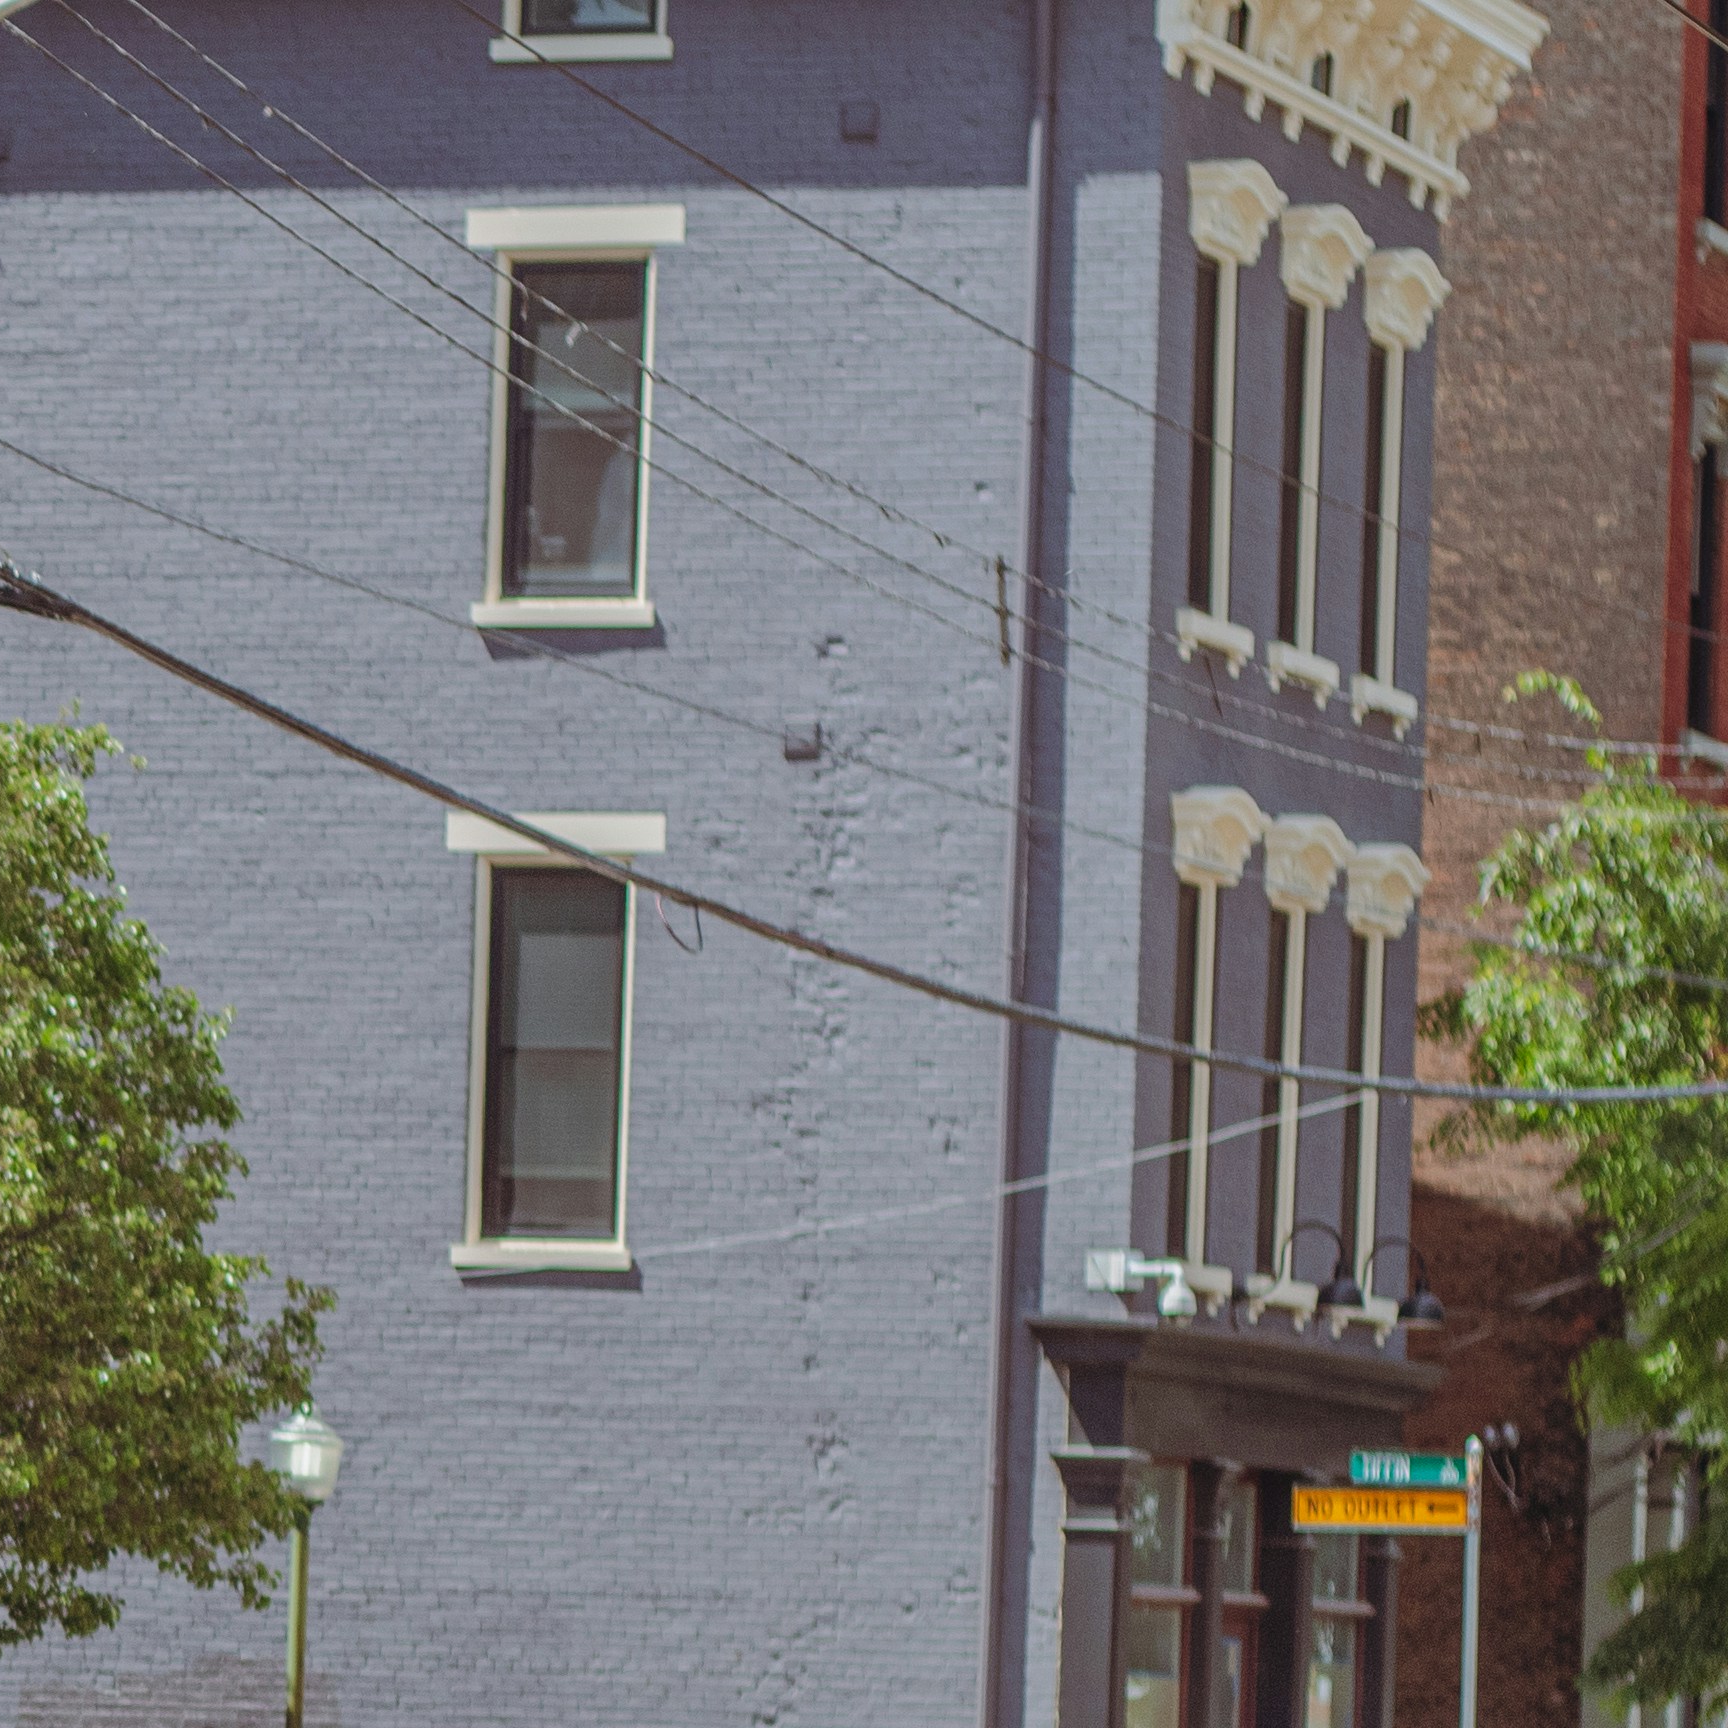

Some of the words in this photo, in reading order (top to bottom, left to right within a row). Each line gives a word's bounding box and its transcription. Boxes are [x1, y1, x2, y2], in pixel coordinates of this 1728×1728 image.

[1361, 1452, 1411, 1484] TIFFIN
[1307, 1496, 1333, 1517] NO
[1345, 1497, 1416, 1520] OUTLET
